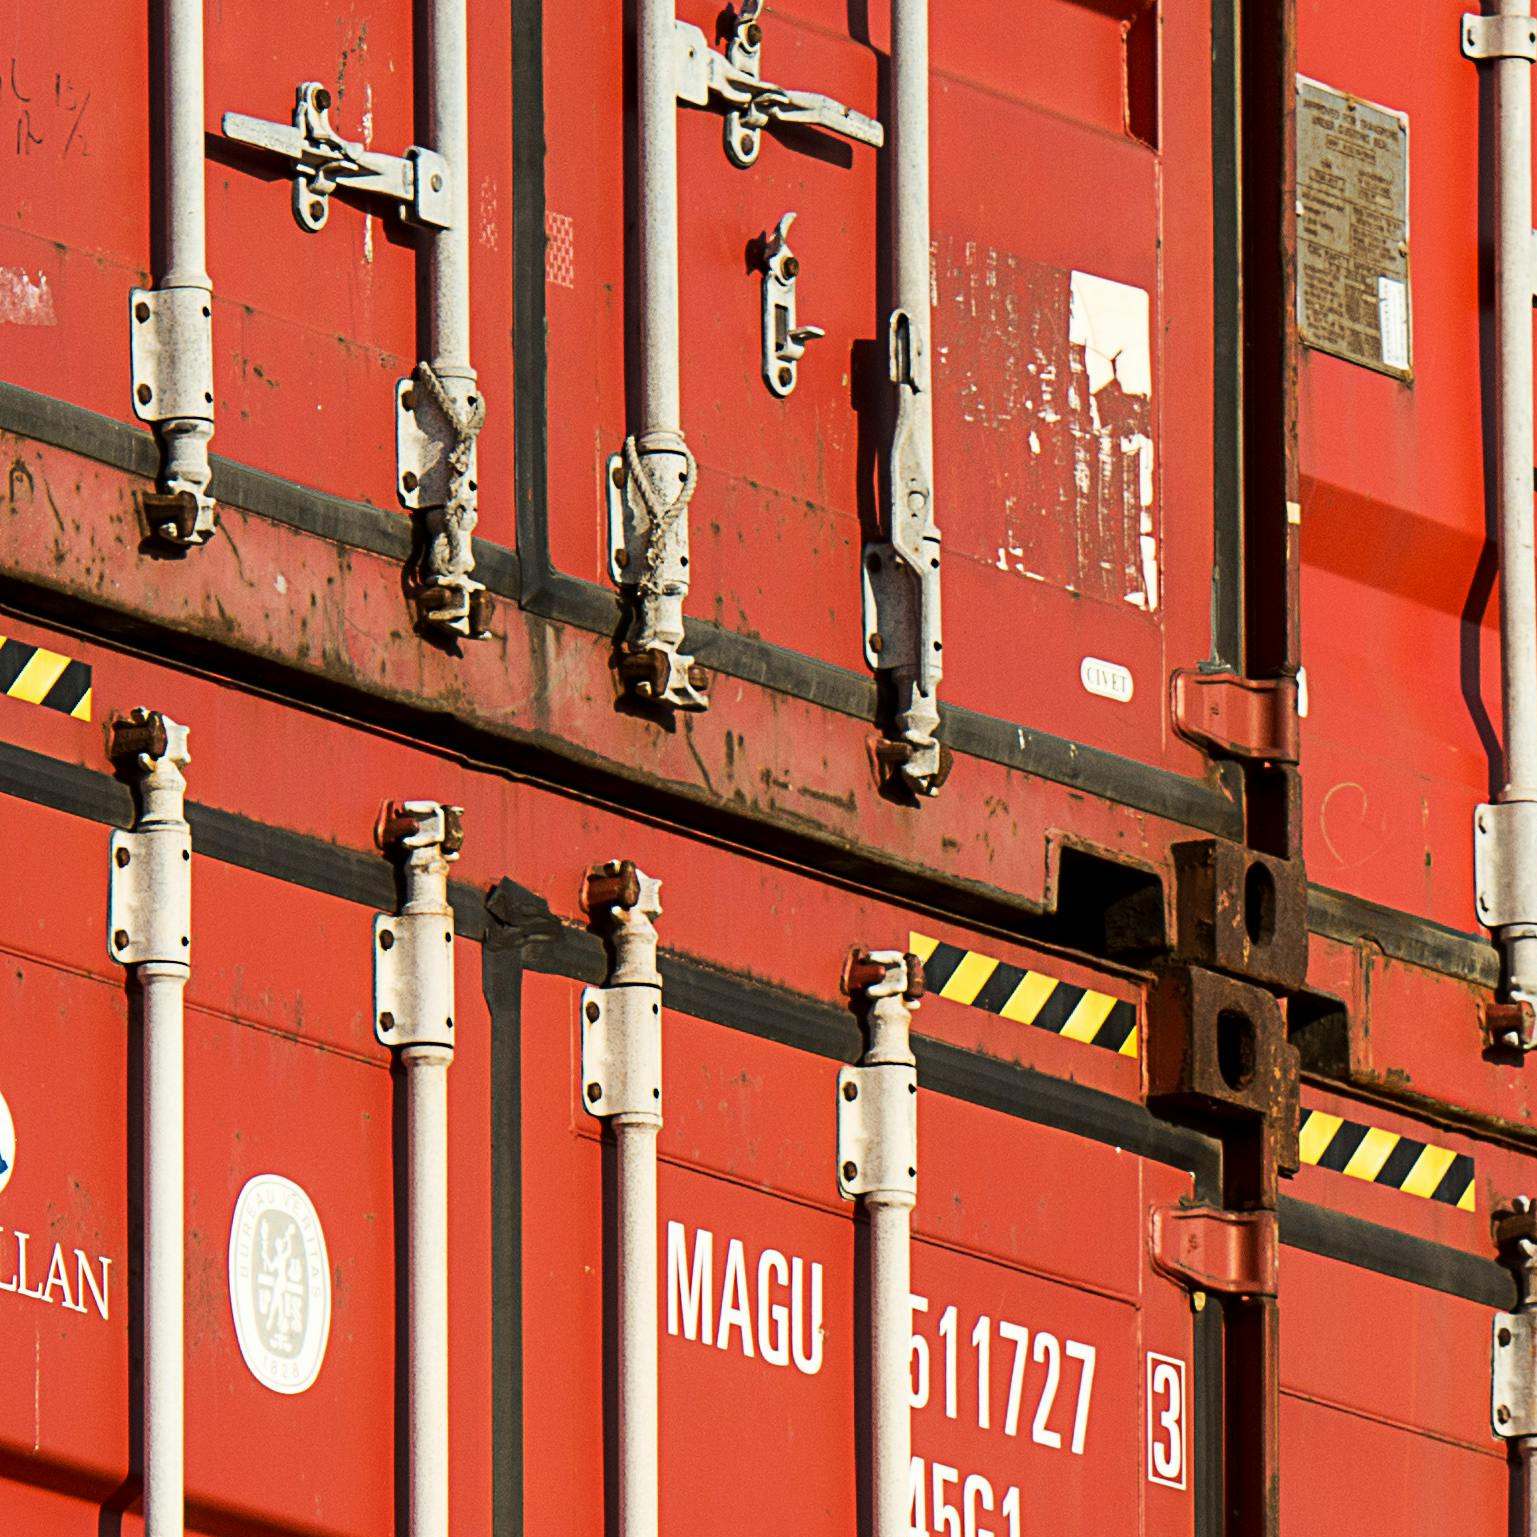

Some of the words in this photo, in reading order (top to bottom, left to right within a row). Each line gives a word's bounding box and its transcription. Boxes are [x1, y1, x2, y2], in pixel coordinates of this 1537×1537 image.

[667, 1219, 825, 1376] MAGU
[909, 1292, 1097, 1456] 511727
[1152, 1362, 1184, 1481] 3
